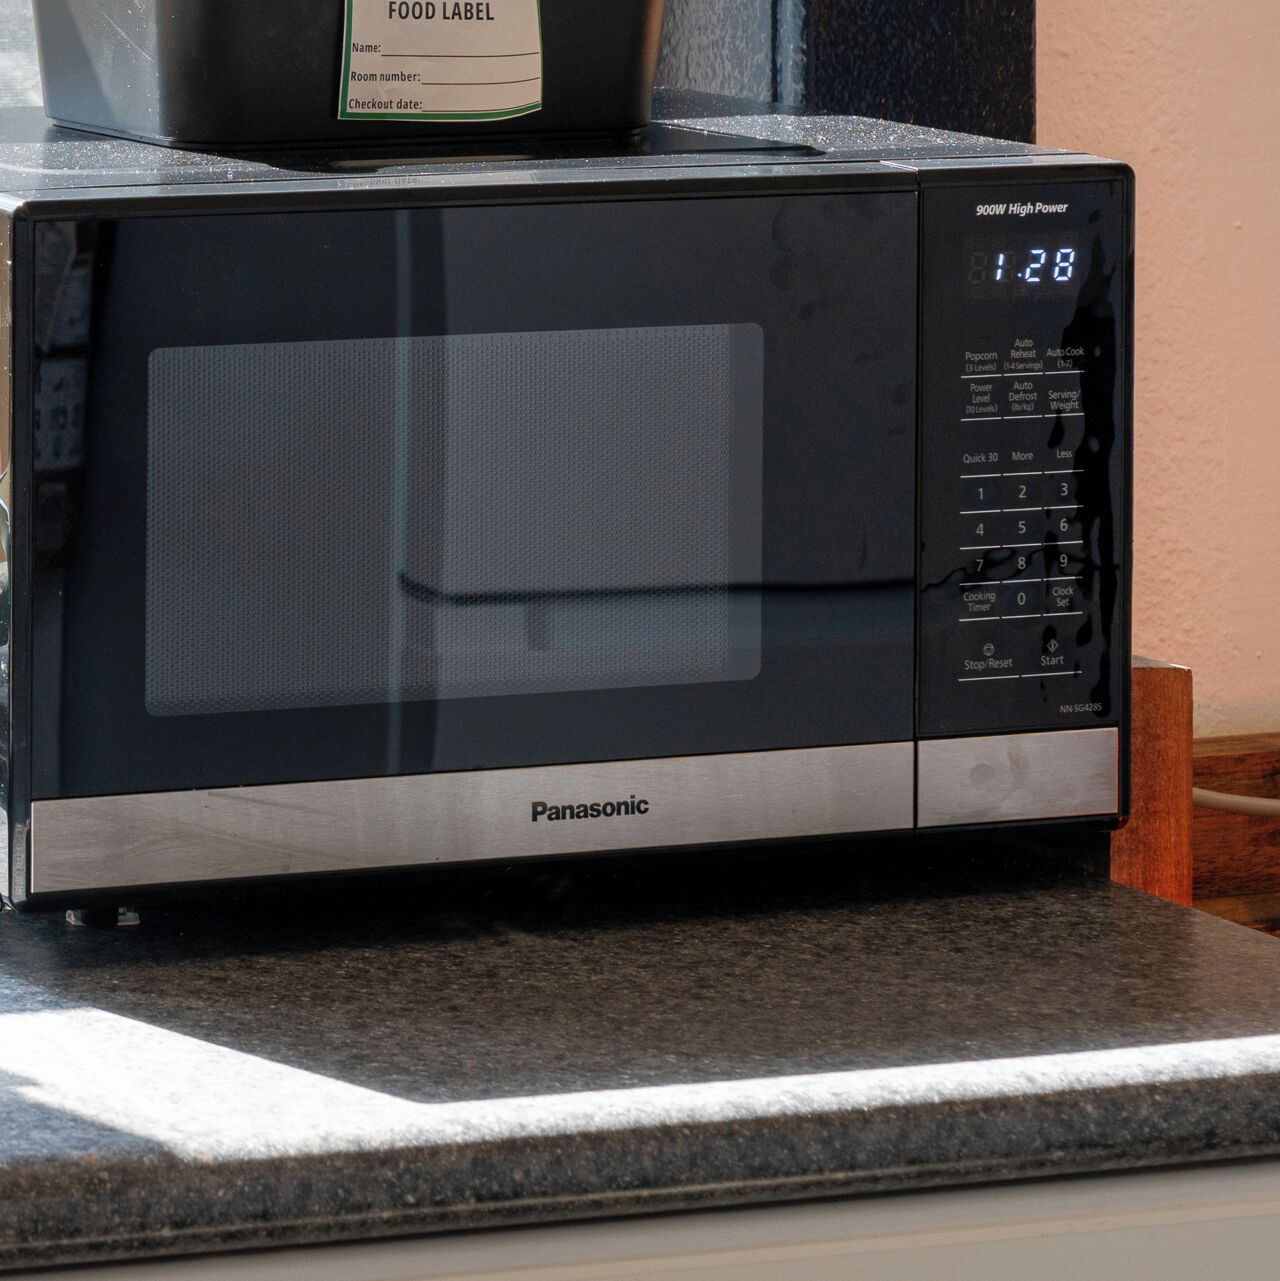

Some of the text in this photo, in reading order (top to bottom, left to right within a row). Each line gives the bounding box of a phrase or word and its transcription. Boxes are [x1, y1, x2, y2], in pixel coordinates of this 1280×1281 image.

[389, 1, 494, 20] FOOD LABEL
[352, 43, 381, 53] Name:
[351, 71, 420, 82] Room number:
[349, 99, 422, 109] Checkout date:
[976, 202, 1068, 217] 900W High Power
[1015, 339, 1033, 347] Auto
[966, 352, 997, 361] Popcorn
[1011, 350, 1036, 358] Reheat
[1047, 347, 1085, 357] Auto Cook
[1013, 381, 1033, 390] Auto
[972, 394, 991, 403] Level
[1009, 392, 1037, 401] Defrost
[1049, 390, 1080, 400] Serving/
[1050, 400, 1079, 411] Weight
[963, 453, 998, 464] Quick 30
[1012, 451, 1033, 461] More
[1057, 449, 1072, 459] Less
[978, 488, 984, 500] 1
[1018, 486, 1027, 498] 2
[1060, 484, 1068, 496] 3
[976, 524, 984, 536] 4
[1018, 521, 1026, 533] 5
[1060, 519, 1068, 531] 6
[977, 560, 984, 571] 7
[1017, 557, 1025, 569] 8
[1059, 554, 1068, 567] 9
[964, 591, 996, 602] Cooking
[1052, 586, 1073, 596] Clock
[1017, 593, 1025, 605] 0
[1056, 597, 1069, 607] Set
[968, 602, 991, 612] Timer
[964, 658, 1013, 670] Stop/Reset
[1040, 655, 1063, 666] Start
[532, 795, 649, 822] Panasonic
